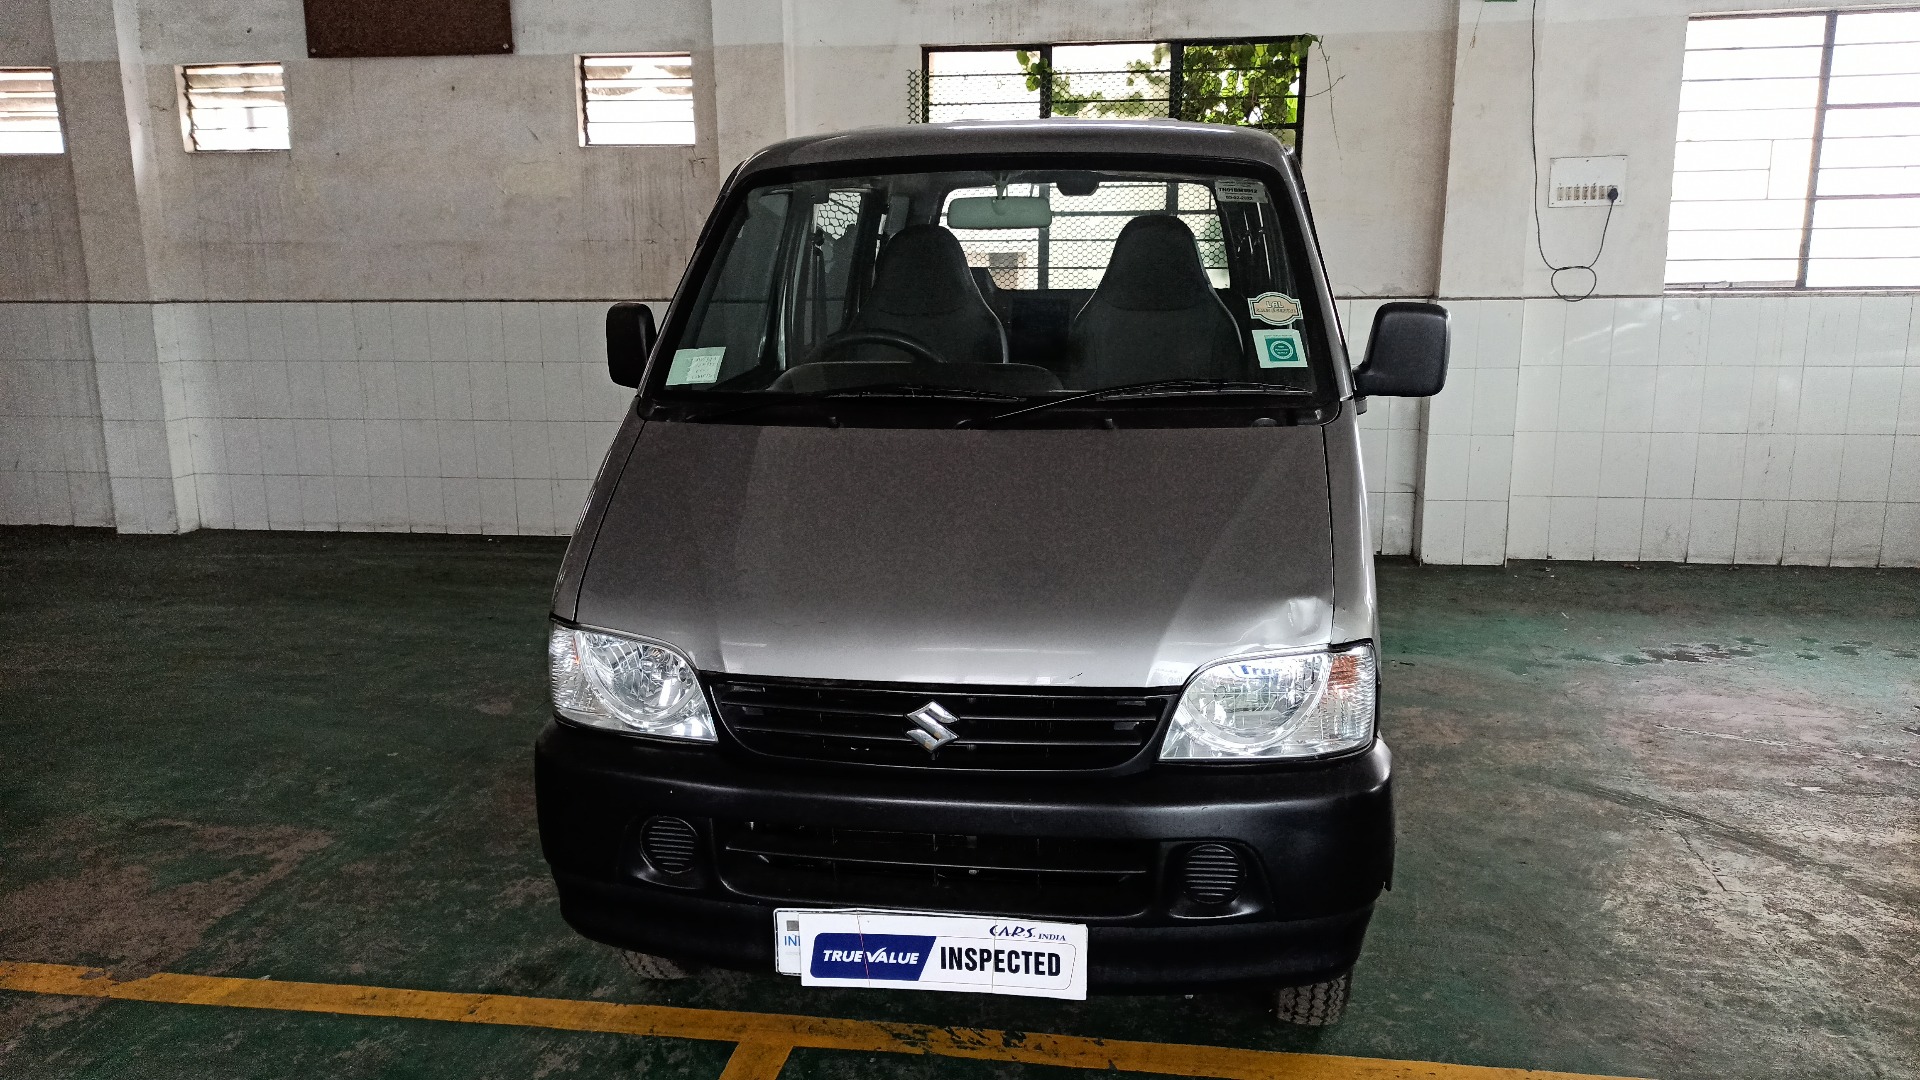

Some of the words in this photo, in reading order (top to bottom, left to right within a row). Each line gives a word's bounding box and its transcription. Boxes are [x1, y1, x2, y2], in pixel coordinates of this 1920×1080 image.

[784, 935, 800, 946] IN
[1038, 933, 1066, 941] INDIA
[940, 946, 1061, 977] INSPECTED
